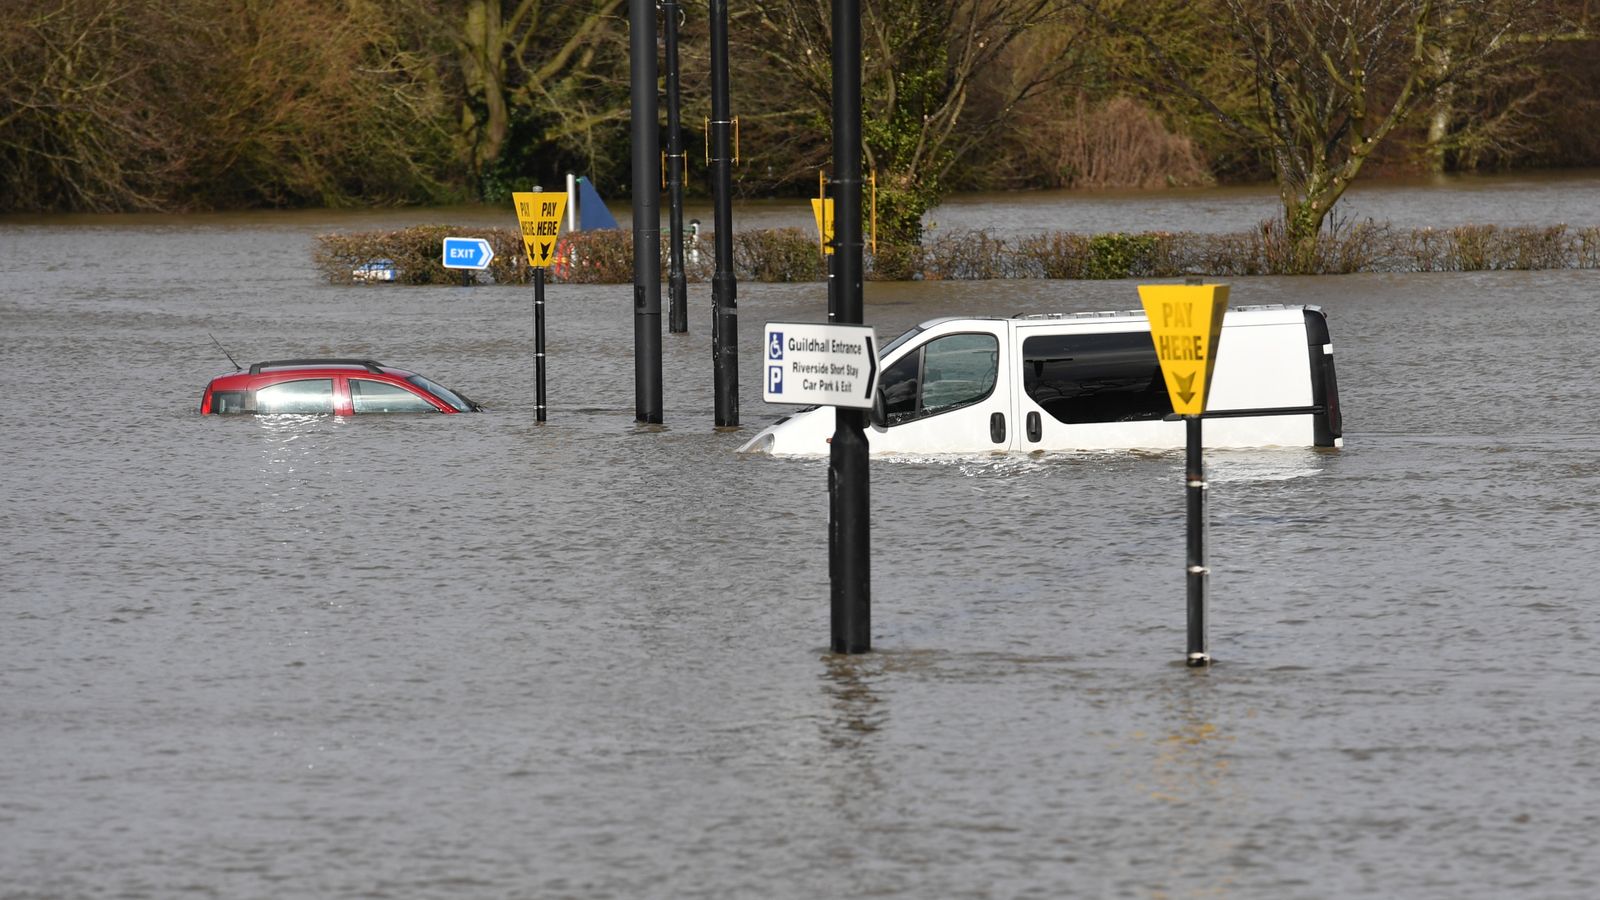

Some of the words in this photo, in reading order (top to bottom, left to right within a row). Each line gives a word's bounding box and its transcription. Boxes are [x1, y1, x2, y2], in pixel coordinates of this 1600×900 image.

[542, 202, 557, 217] PAY
[537, 221, 558, 236] HERE
[450, 248, 475, 258] EXIT
[1162, 302, 1193, 328] PAY
[788, 337, 830, 352] Guildhall
[832, 340, 862, 355] Entrance
[1159, 335, 1203, 360] HERE
[792, 362, 828, 374] Riverside
[830, 364, 845, 375] Short
[846, 364, 859, 378] Stay
[770, 367, 782, 392] P
[802, 379, 817, 390] Car
[820, 380, 834, 392] Park
[836, 381, 840, 392] &
[841, 381, 852, 392] Exit
